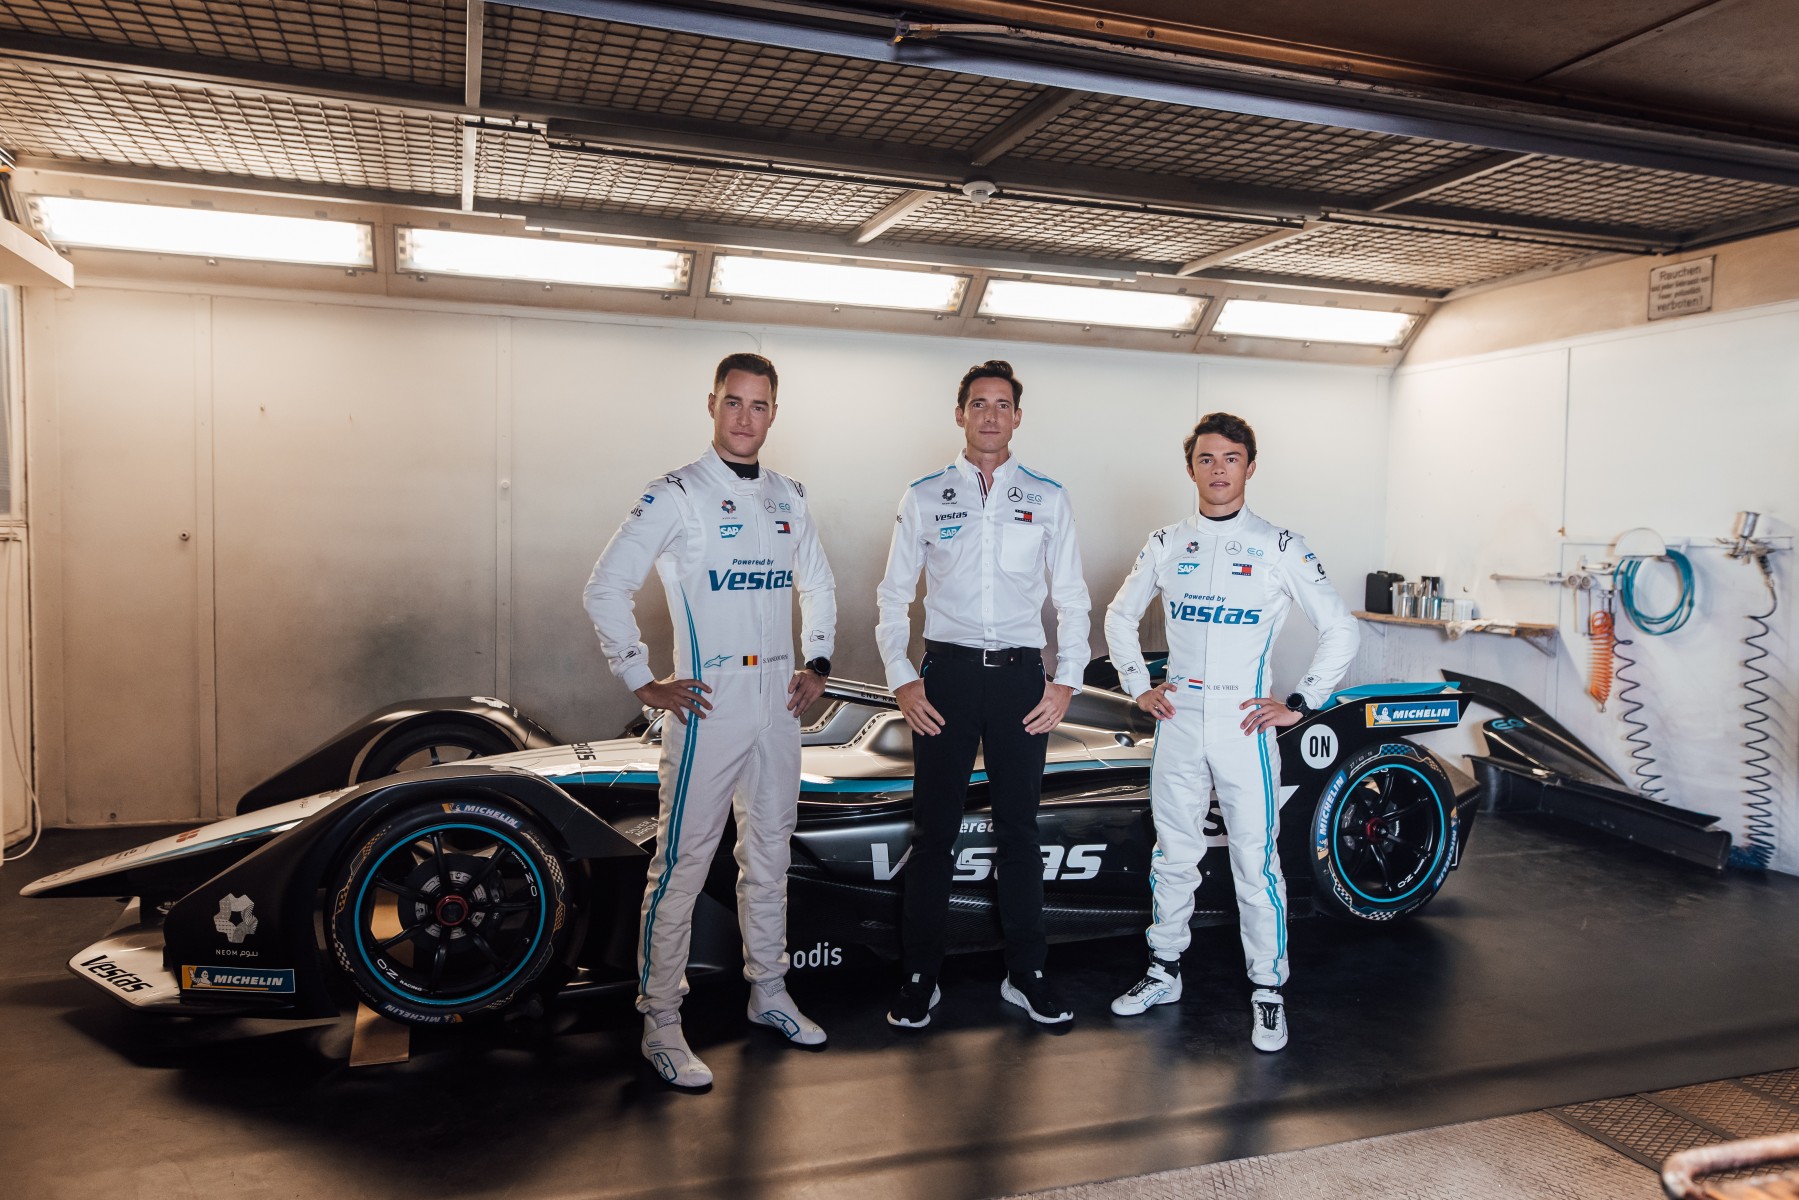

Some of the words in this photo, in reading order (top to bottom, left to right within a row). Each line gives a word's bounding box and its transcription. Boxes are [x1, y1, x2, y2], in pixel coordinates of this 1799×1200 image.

[720, 526, 739, 537] SAP
[940, 529, 957, 538] SAP
[732, 558, 766, 566] Powered
[766, 558, 774, 567] by
[1178, 564, 1195, 573] SAP
[708, 568, 793, 592] Vestas
[1183, 592, 1215, 601] Powered
[1216, 595, 1227, 603] by
[1169, 601, 1263, 625] Vestas
[860, 691, 879, 700] END
[1392, 707, 1451, 719] MICHELIN
[1309, 735, 1331, 758] ON
[1319, 776, 1345, 836] MICHELIN
[463, 804, 519, 829] MICHELIN
[792, 941, 843, 969] odis
[79, 954, 154, 993] Vestas
[213, 974, 284, 986] MICHELIN
[385, 1003, 441, 1023] MICHELIN
